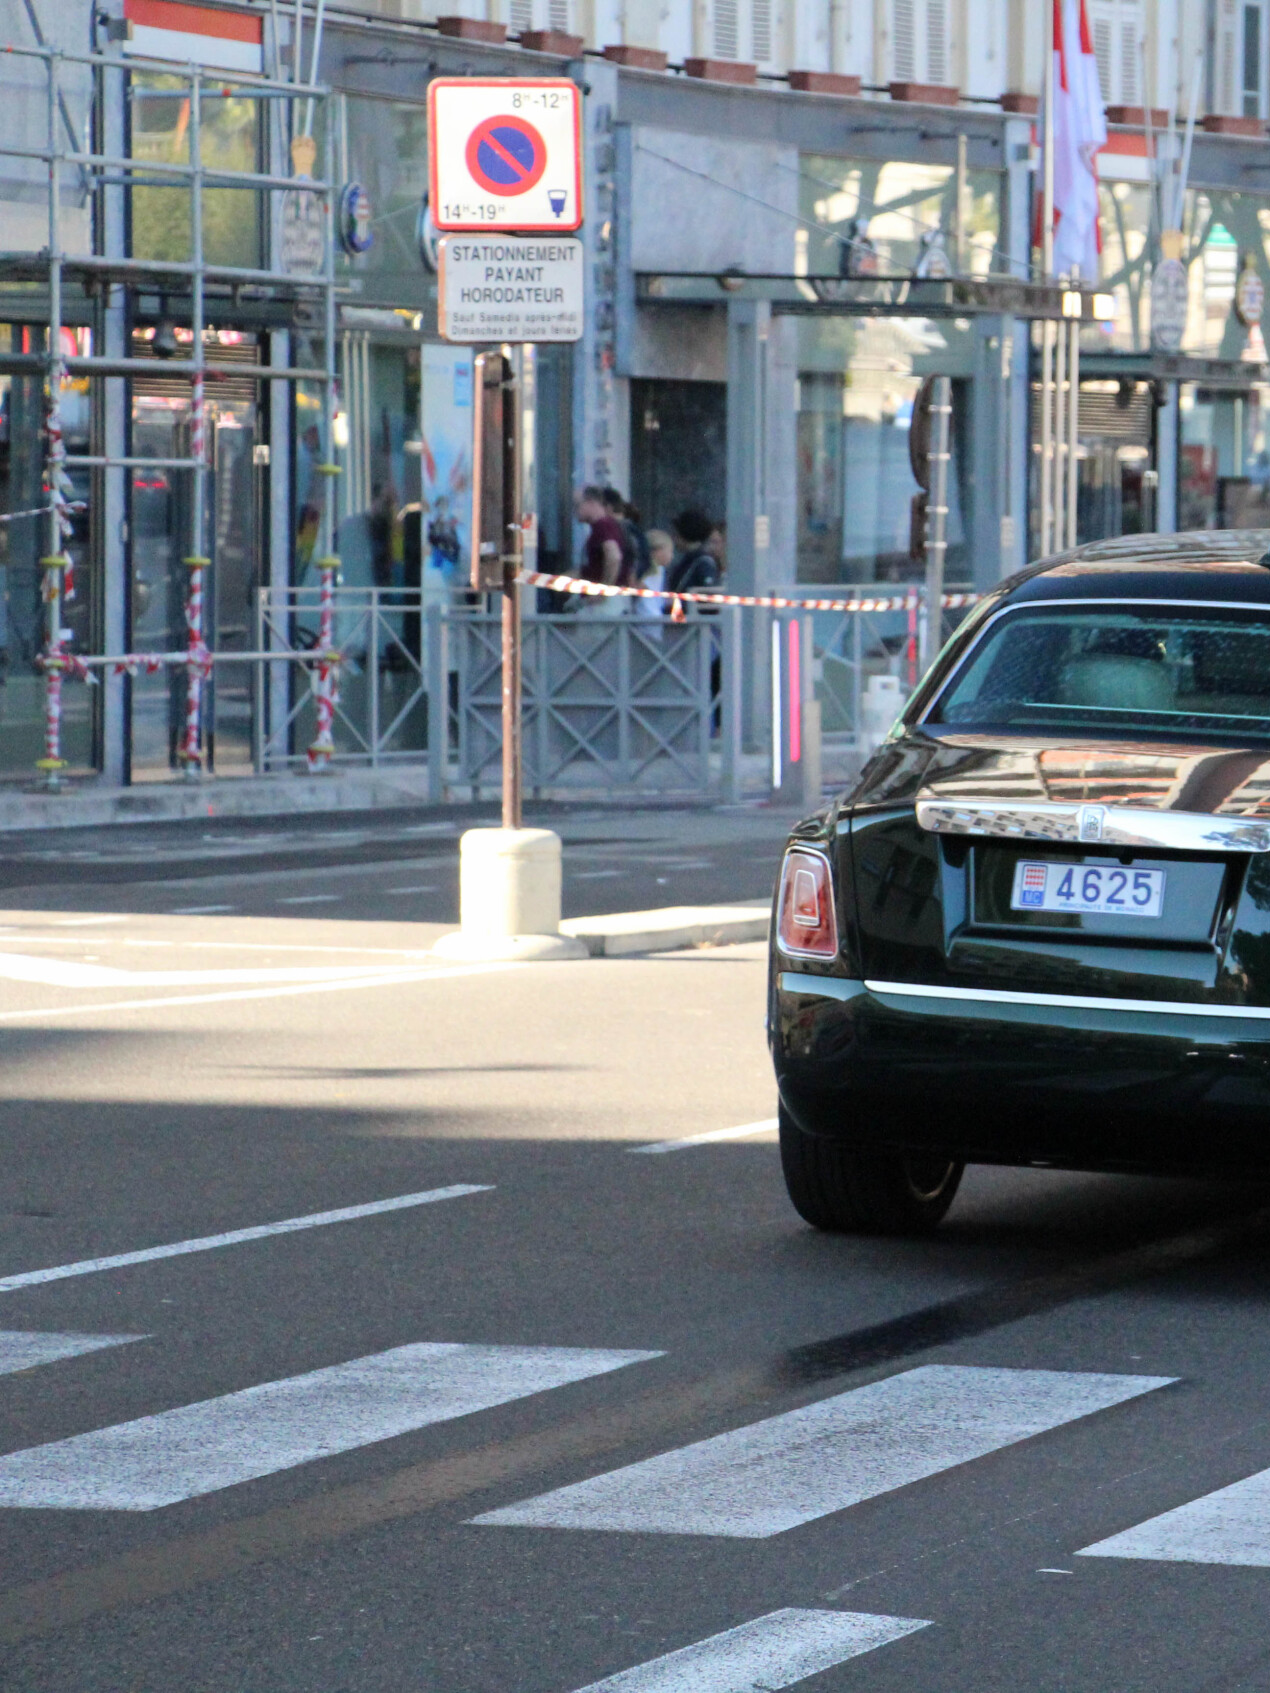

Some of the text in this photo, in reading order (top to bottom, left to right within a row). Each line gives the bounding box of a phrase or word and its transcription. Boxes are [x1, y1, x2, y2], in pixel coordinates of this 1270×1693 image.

[453, 245, 576, 262] STATIONNEMENT
[484, 266, 544, 283] PAYANT
[461, 287, 564, 303] HORODATEUR
[1056, 868, 1152, 906] 4625
